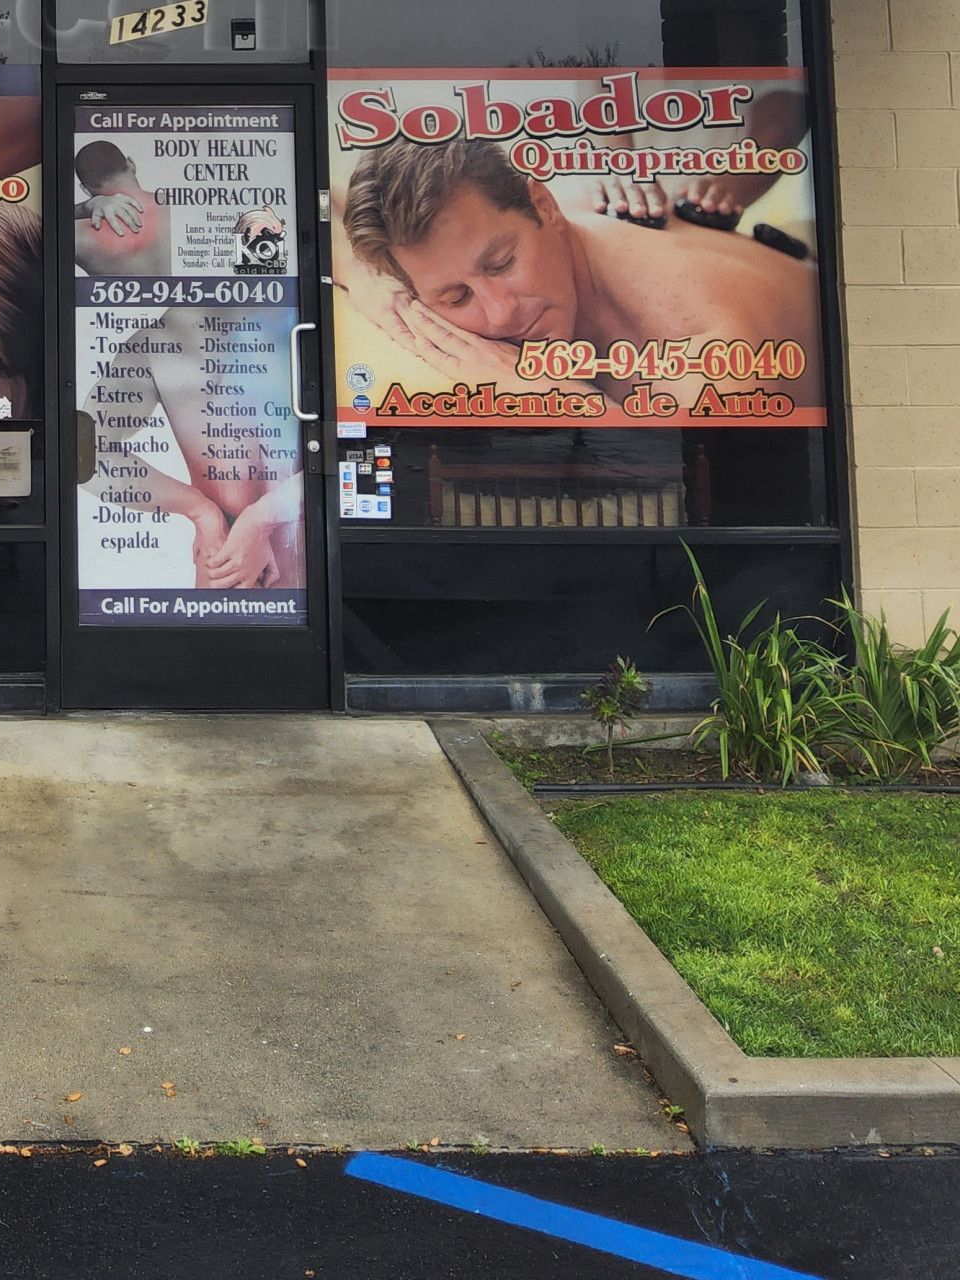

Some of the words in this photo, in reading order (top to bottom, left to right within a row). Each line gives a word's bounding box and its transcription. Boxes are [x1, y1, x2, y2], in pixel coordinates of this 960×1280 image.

[117, 0, 208, 41] 14233
[335, 71, 754, 151] Sobador
[90, 113, 125, 129] Call
[128, 113, 155, 129] For
[160, 112, 279, 131] Appointment
[154, 139, 201, 158] BODY
[207, 139, 277, 158] HEALING
[509, 138, 808, 184] Quiropractico
[184, 163, 249, 182] CENTER
[154, 187, 288, 206] CHIROPRACTOR
[265, 260, 287, 268] CBD
[90, 280, 284, 304] 562-945-6040
[89, 312, 166, 334] -Migrañas
[199, 317, 262, 336] -Migrains
[90, 336, 183, 354] -Torseduras
[199, 337, 276, 353] -Distension
[199, 358, 268, 374] -Dizziness
[515, 338, 807, 382] 562-945-6040
[90, 361, 153, 379] -Mareos
[90, 385, 144, 403] -Estres
[200, 380, 245, 396] -Stress
[201, 401, 257, 417] -Suction
[376, 384, 607, 418] Accidentes
[622, 384, 680, 418] de
[689, 384, 795, 418] Auto
[201, 422, 282, 441] -Indigestion
[202, 444, 252, 460] -Sciatic
[258, 444, 297, 460] Nerve
[202, 465, 241, 481] -Back
[248, 465, 278, 481] Pain
[100, 485, 152, 503] ciatico
[92, 506, 144, 524] -Dolor
[151, 506, 170, 524] de
[100, 531, 160, 553] espalda
[101, 597, 135, 614] Call
[139, 597, 169, 614] For
[173, 597, 296, 617] Appointment
